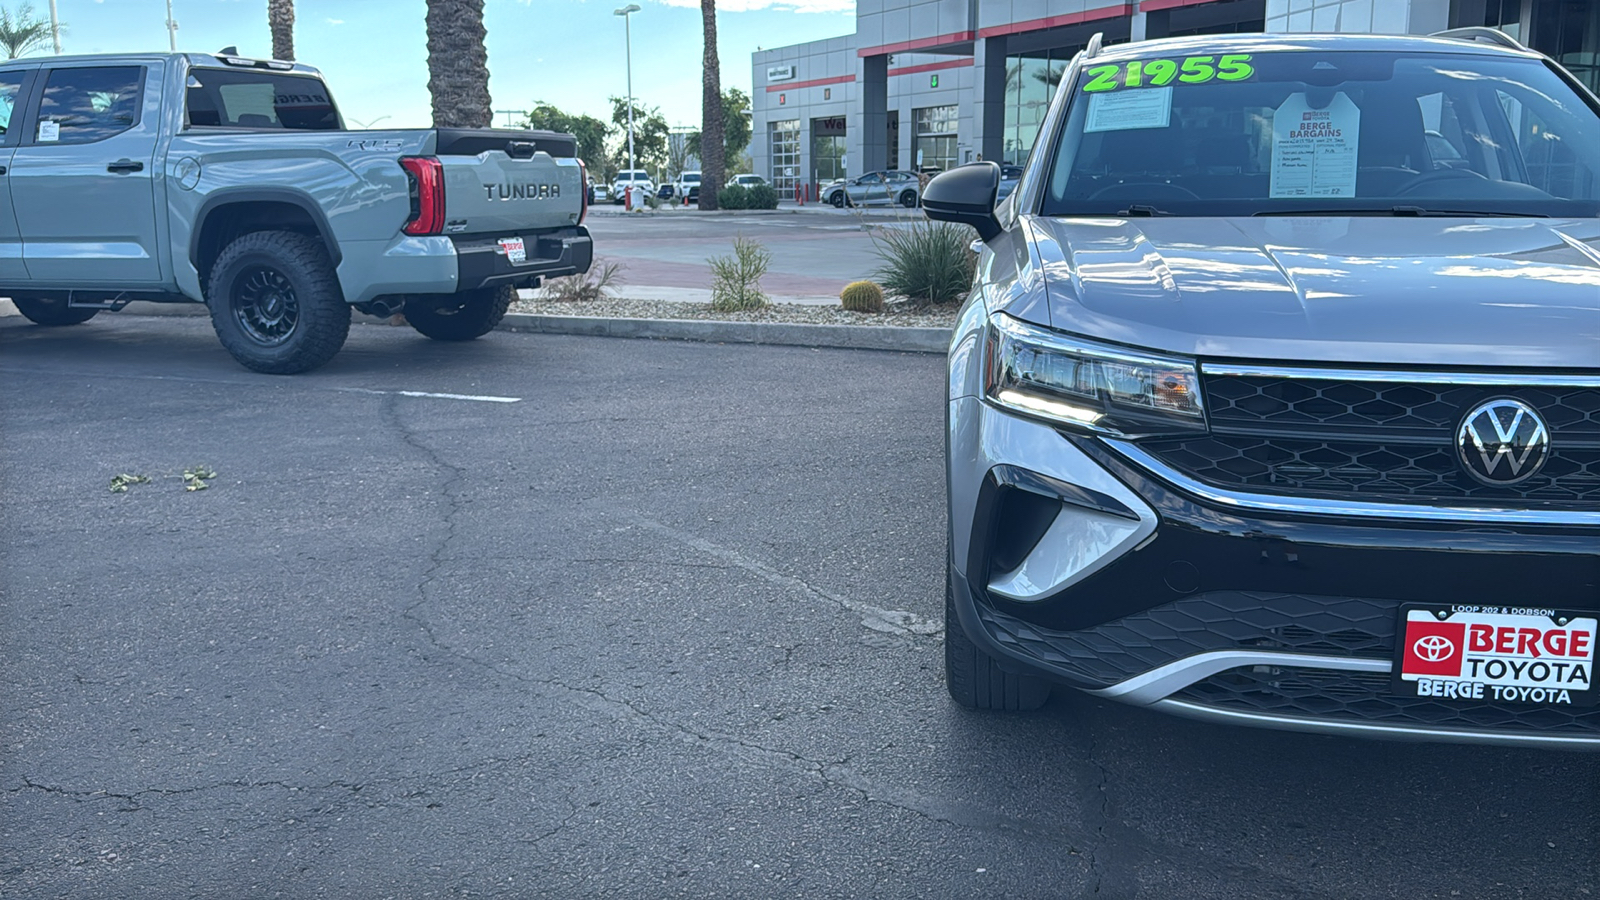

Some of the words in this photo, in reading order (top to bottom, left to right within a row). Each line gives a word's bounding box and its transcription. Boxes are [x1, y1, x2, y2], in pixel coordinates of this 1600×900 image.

[1083, 54, 1254, 91] 21955
[1290, 130, 1341, 138] BARGAINS
[483, 183, 560, 201] TUNDRA
[1511, 608, 1555, 617] DOBSON
[1469, 624, 1590, 658] BERGE
[1467, 658, 1589, 684] TOYOTA
[1417, 679, 1484, 699] BERGE
[1492, 686, 1571, 704] TOYOTA
